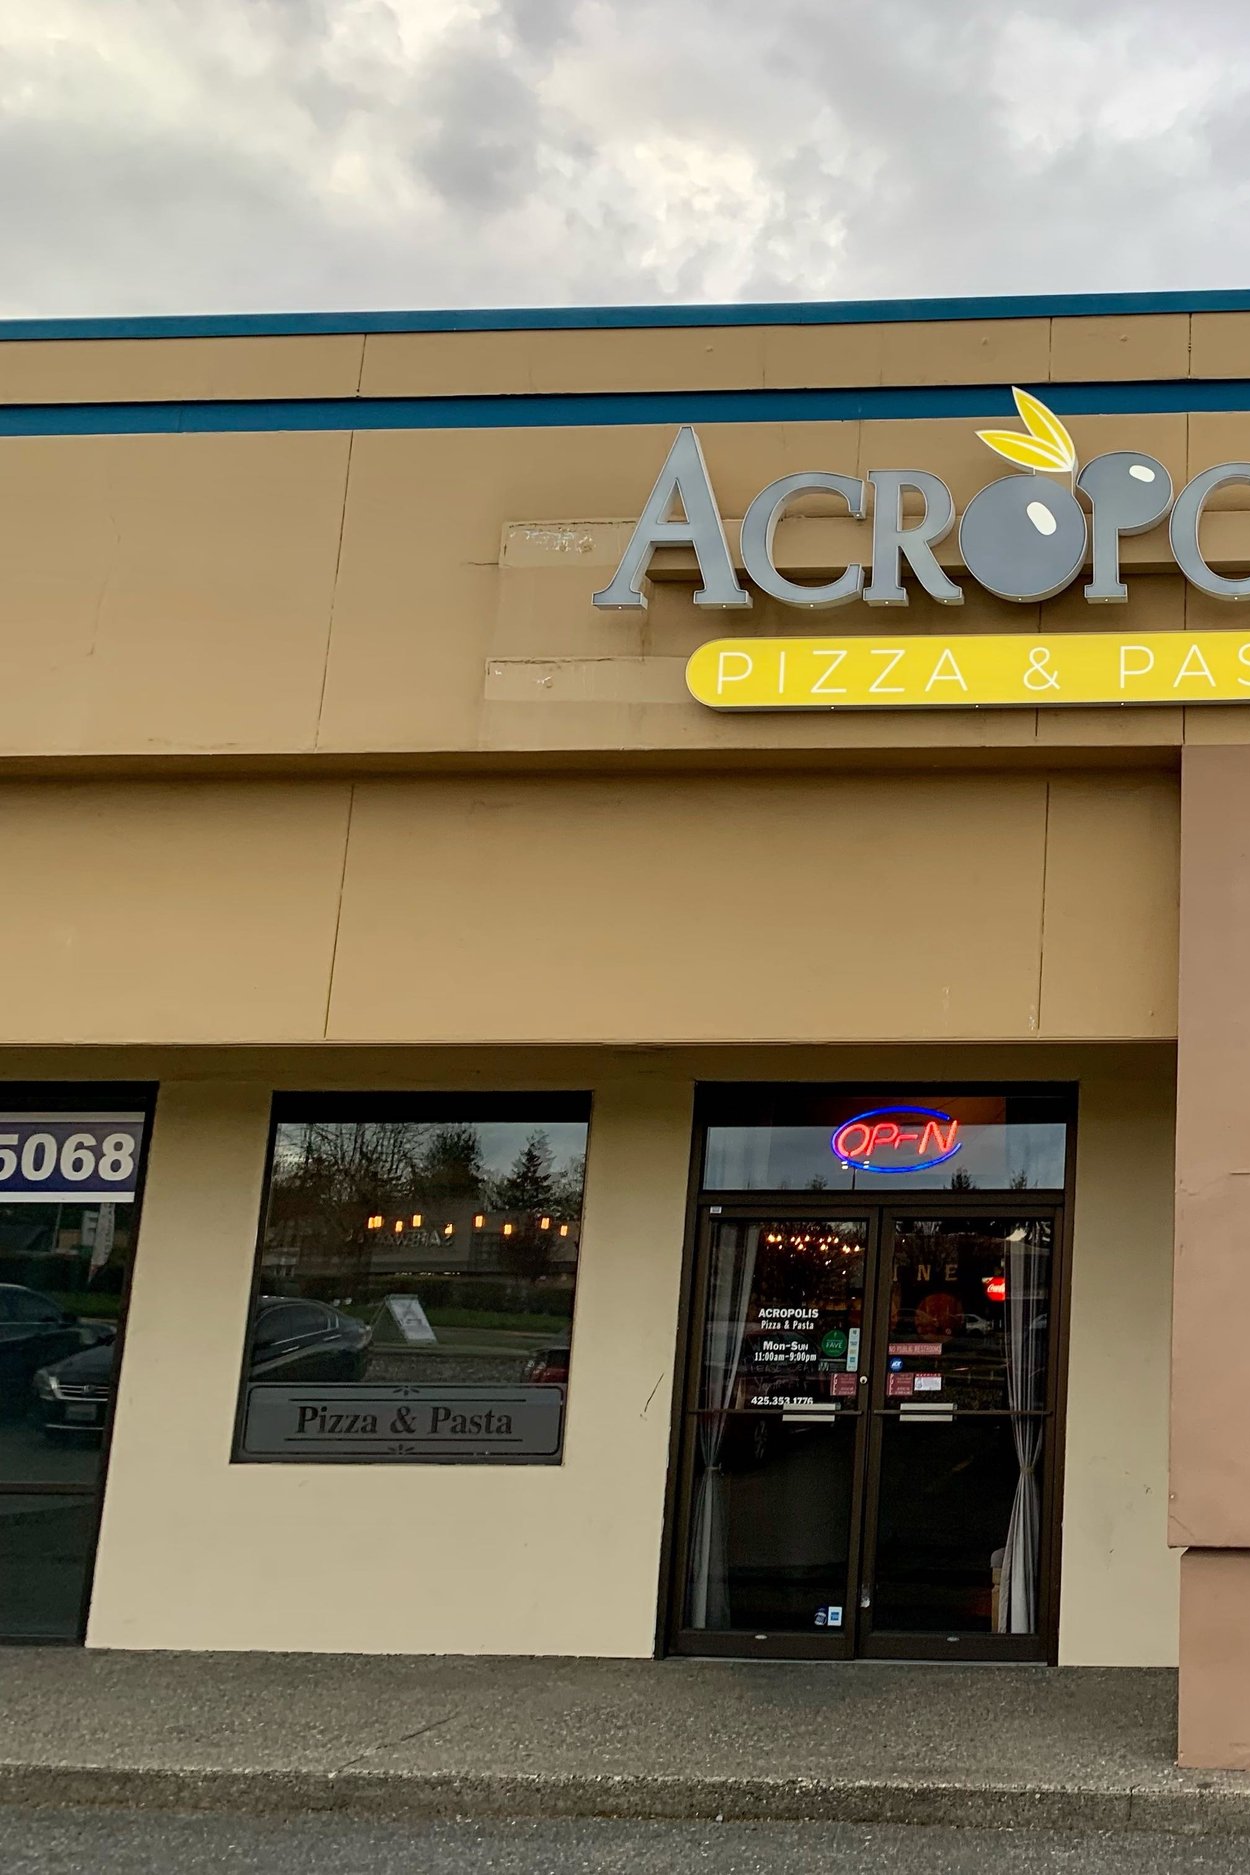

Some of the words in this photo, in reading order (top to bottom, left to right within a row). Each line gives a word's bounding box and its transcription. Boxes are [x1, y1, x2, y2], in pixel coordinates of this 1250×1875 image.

[716, 647, 970, 695] PIZZA
[1022, 649, 1061, 691] &
[758, 1308, 819, 1318] ACROPOLIS
[761, 1320, 781, 1330] Pizza
[784, 1320, 790, 1329] &
[793, 1320, 814, 1330] Pasta
[751, 1396, 814, 1406] 425.3531776
[297, 1406, 378, 1434] Pizza
[390, 1406, 417, 1434] &
[427, 1406, 513, 1435] Pasta
